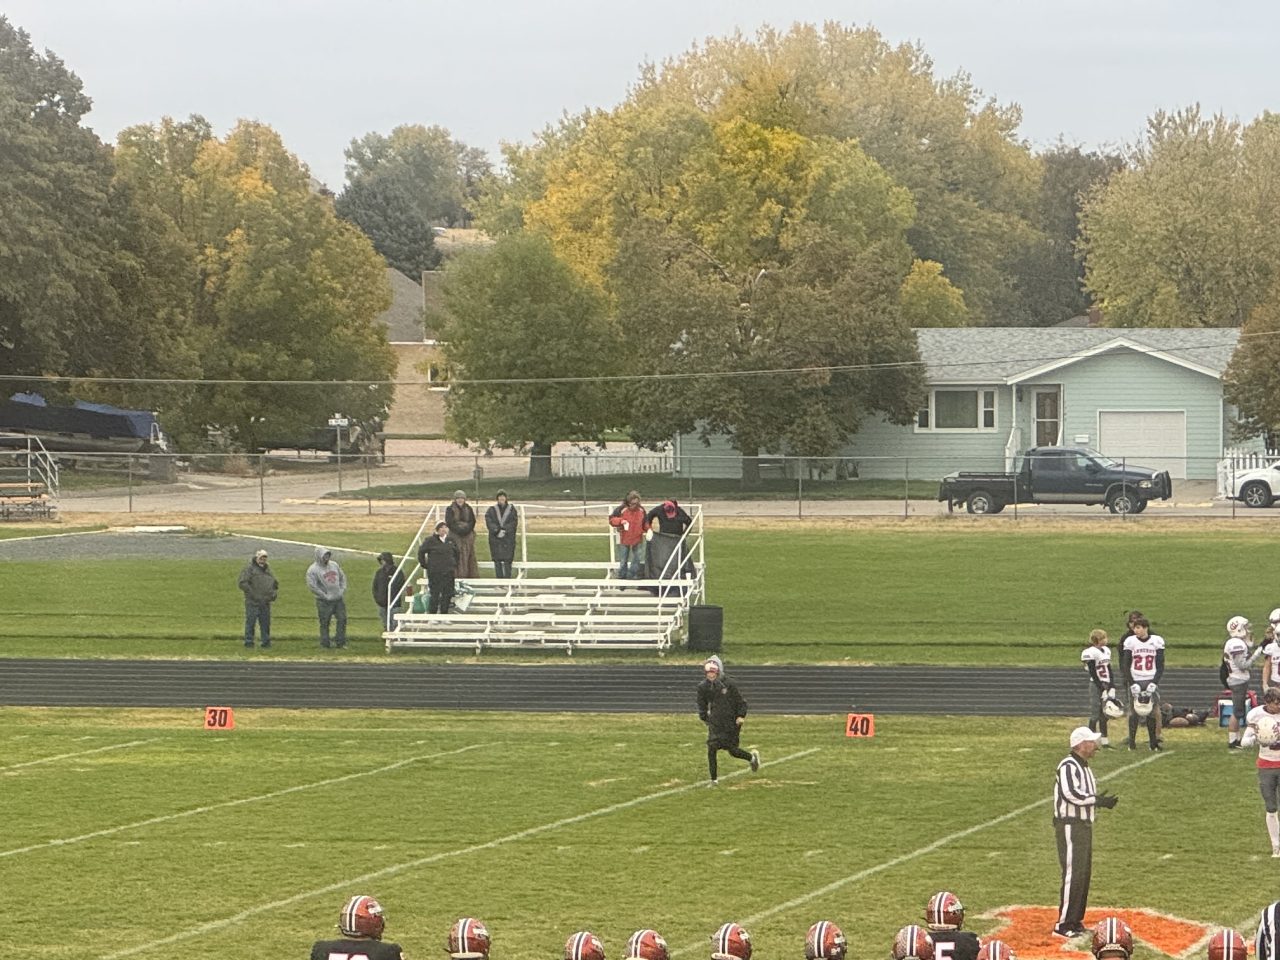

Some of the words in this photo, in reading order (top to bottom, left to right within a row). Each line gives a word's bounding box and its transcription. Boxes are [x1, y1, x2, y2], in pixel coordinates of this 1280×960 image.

[1133, 655, 1154, 671] 28
[208, 709, 227, 727] 30
[849, 716, 870, 736] 40
